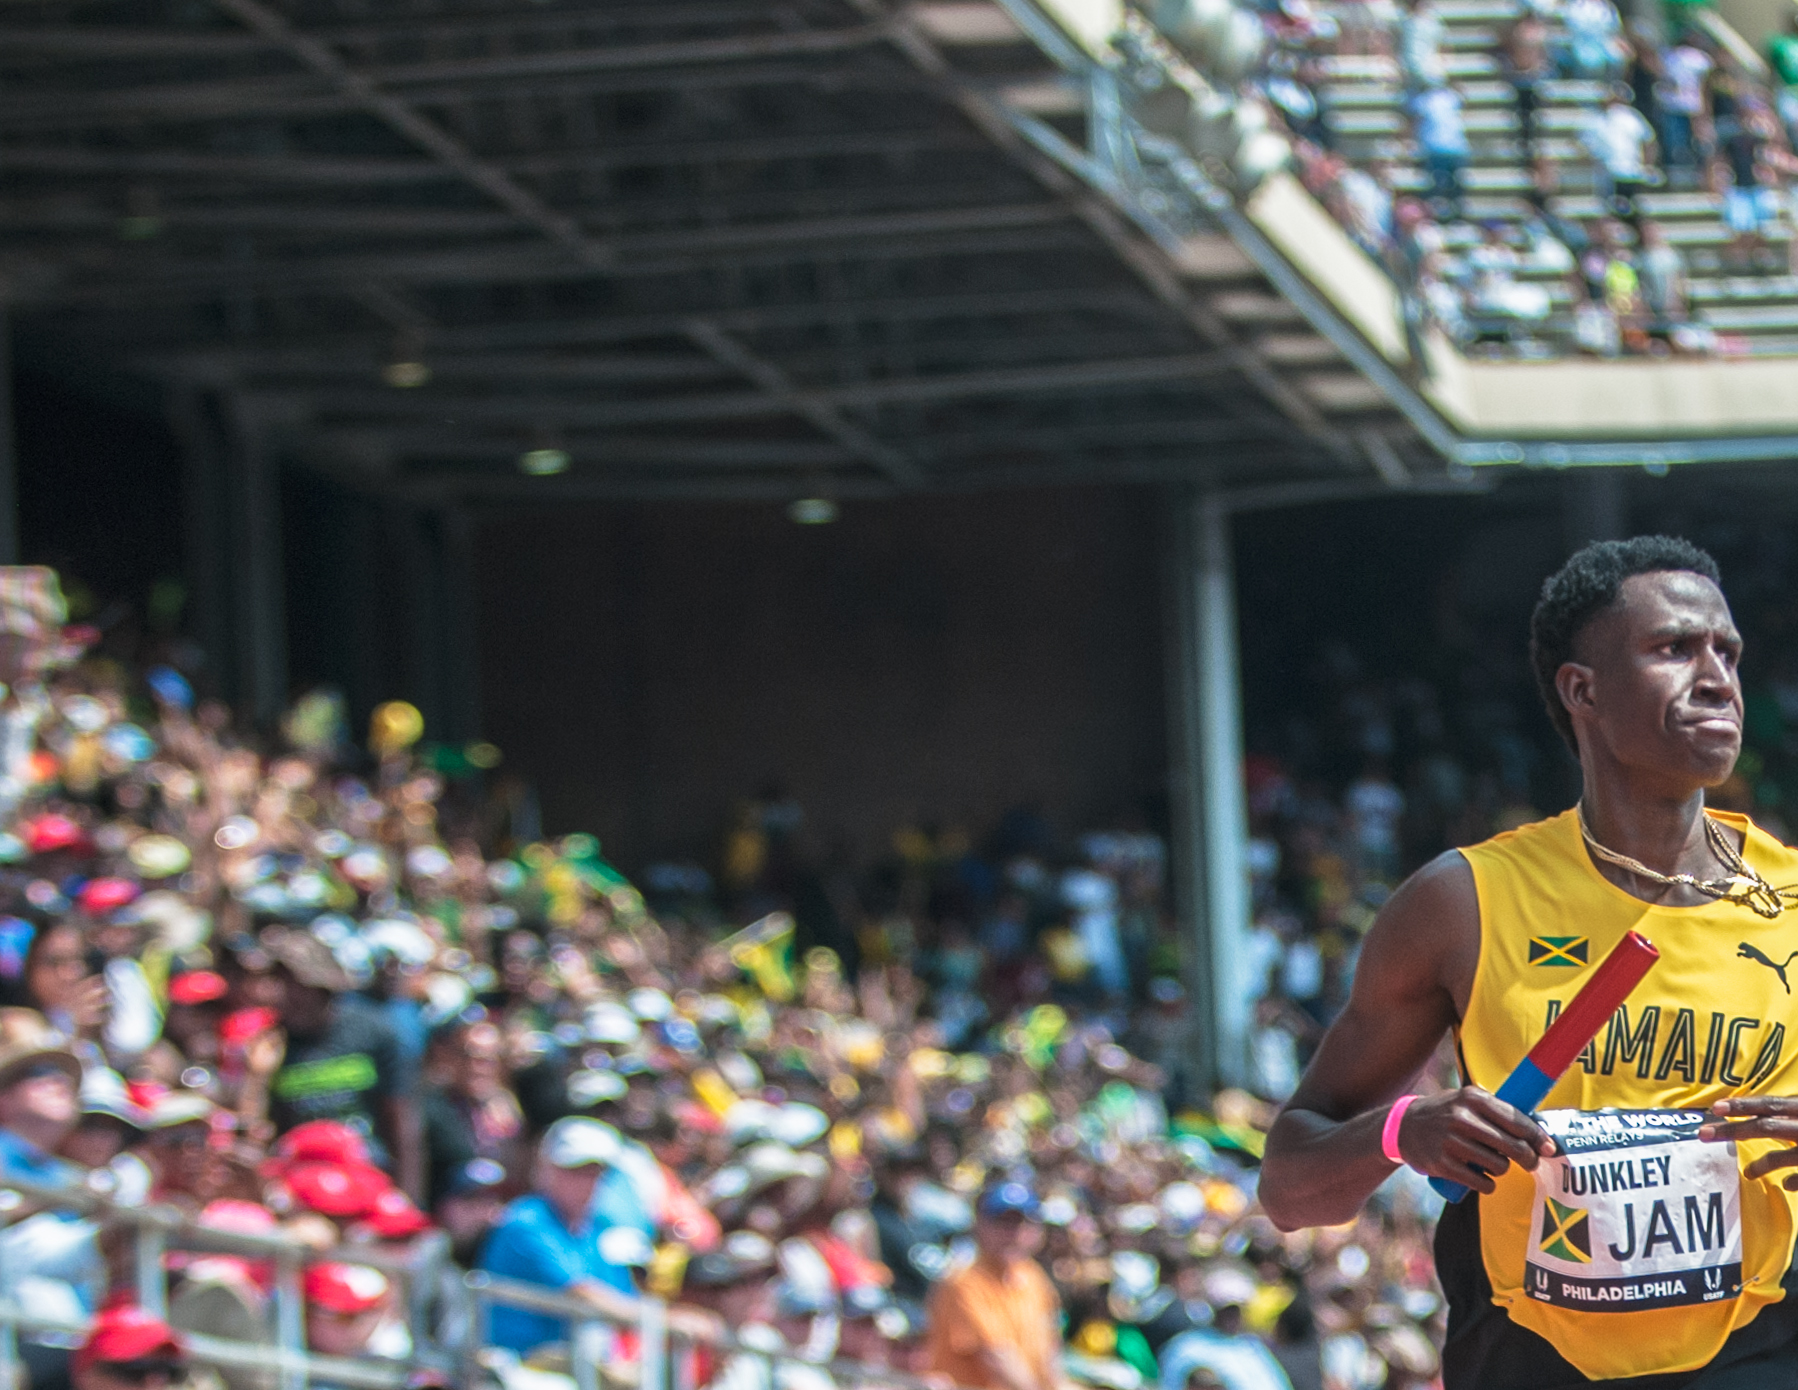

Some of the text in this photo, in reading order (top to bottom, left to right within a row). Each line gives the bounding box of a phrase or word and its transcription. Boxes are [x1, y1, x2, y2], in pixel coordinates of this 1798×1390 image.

[1577, 1115, 1624, 1132] THE
[1622, 1113, 1704, 1127] WORLD
[1566, 1131, 1645, 1148] PENN RELAYS
[1608, 1191, 1726, 1262] JAM
[1562, 1280, 1688, 1301] PHILADELPHIA
